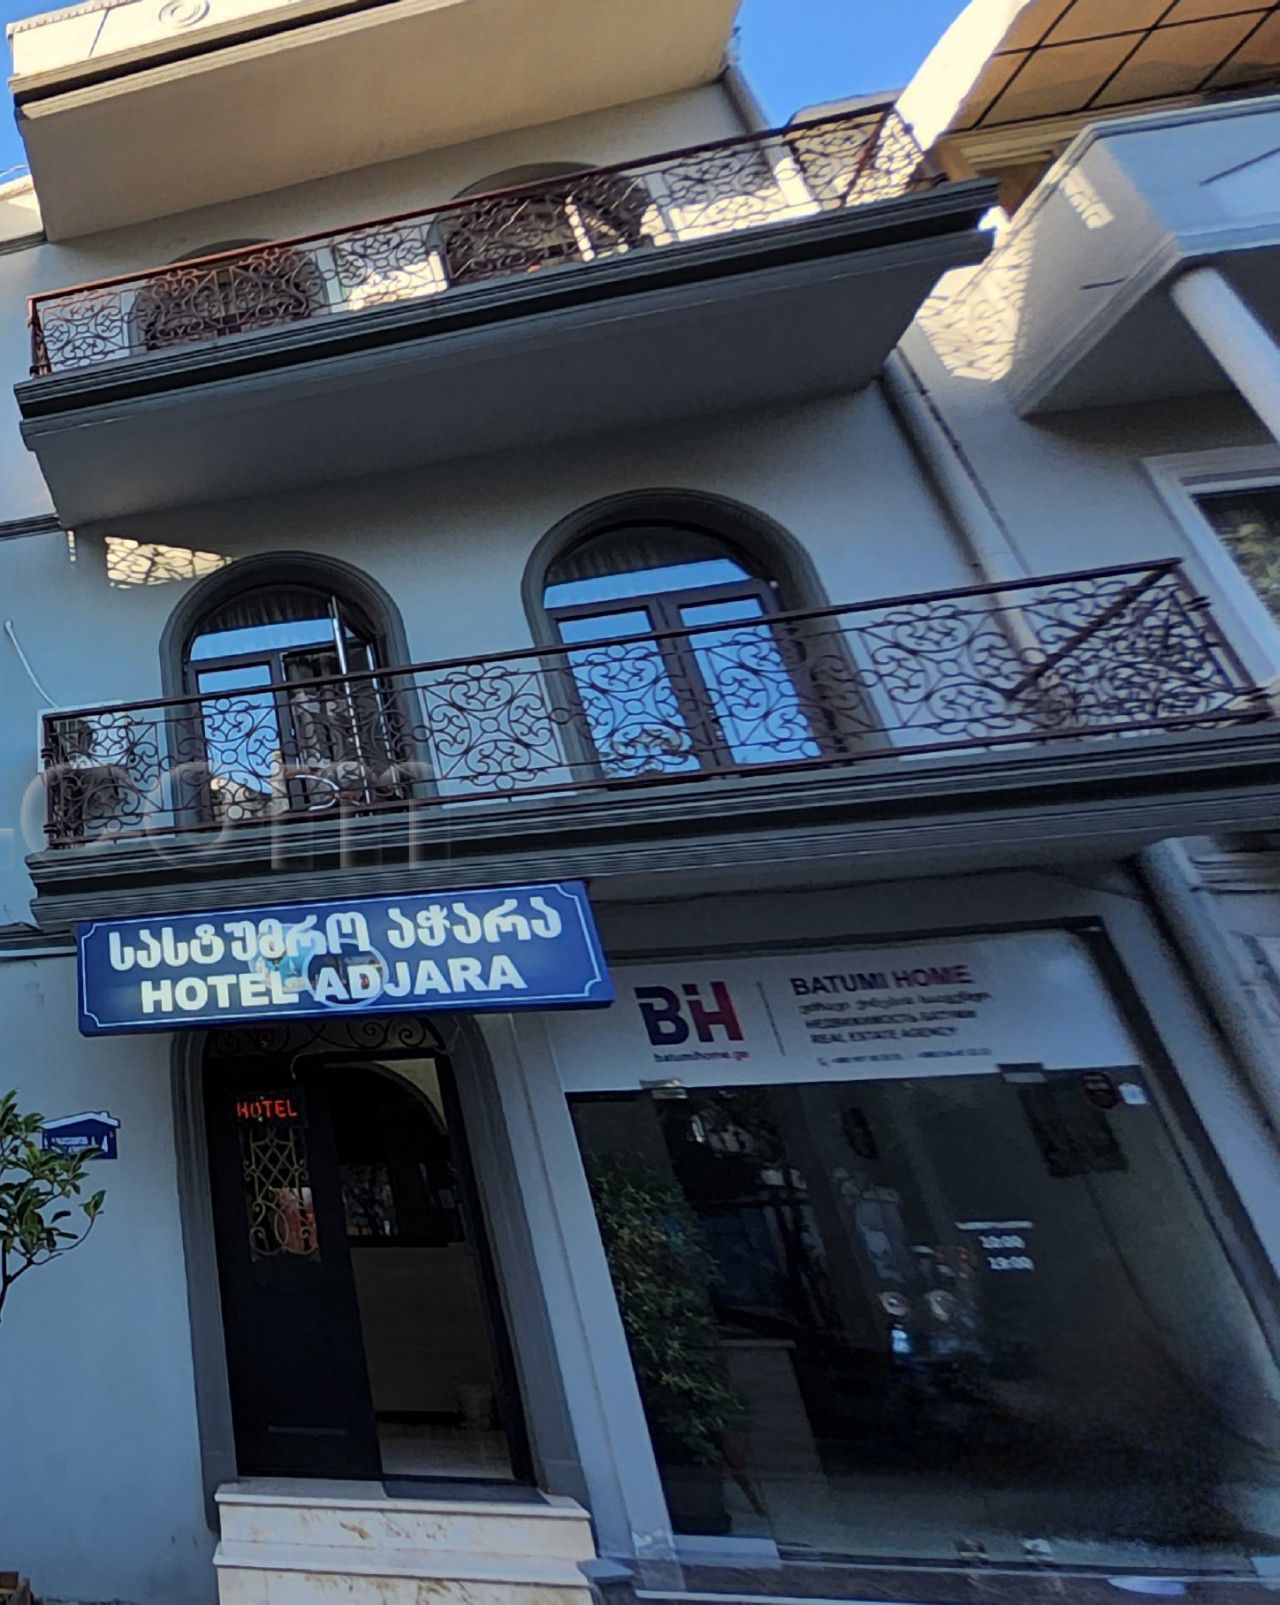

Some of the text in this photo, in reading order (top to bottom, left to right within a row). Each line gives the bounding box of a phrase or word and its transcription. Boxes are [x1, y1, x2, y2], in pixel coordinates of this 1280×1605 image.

[108, 896, 562, 971] სასტუმრო აჭარა
[141, 954, 528, 1014] HOTEL ADJARA
[790, 964, 974, 996] BATUMI HOME
[236, 1099, 298, 1119] HOTEL
